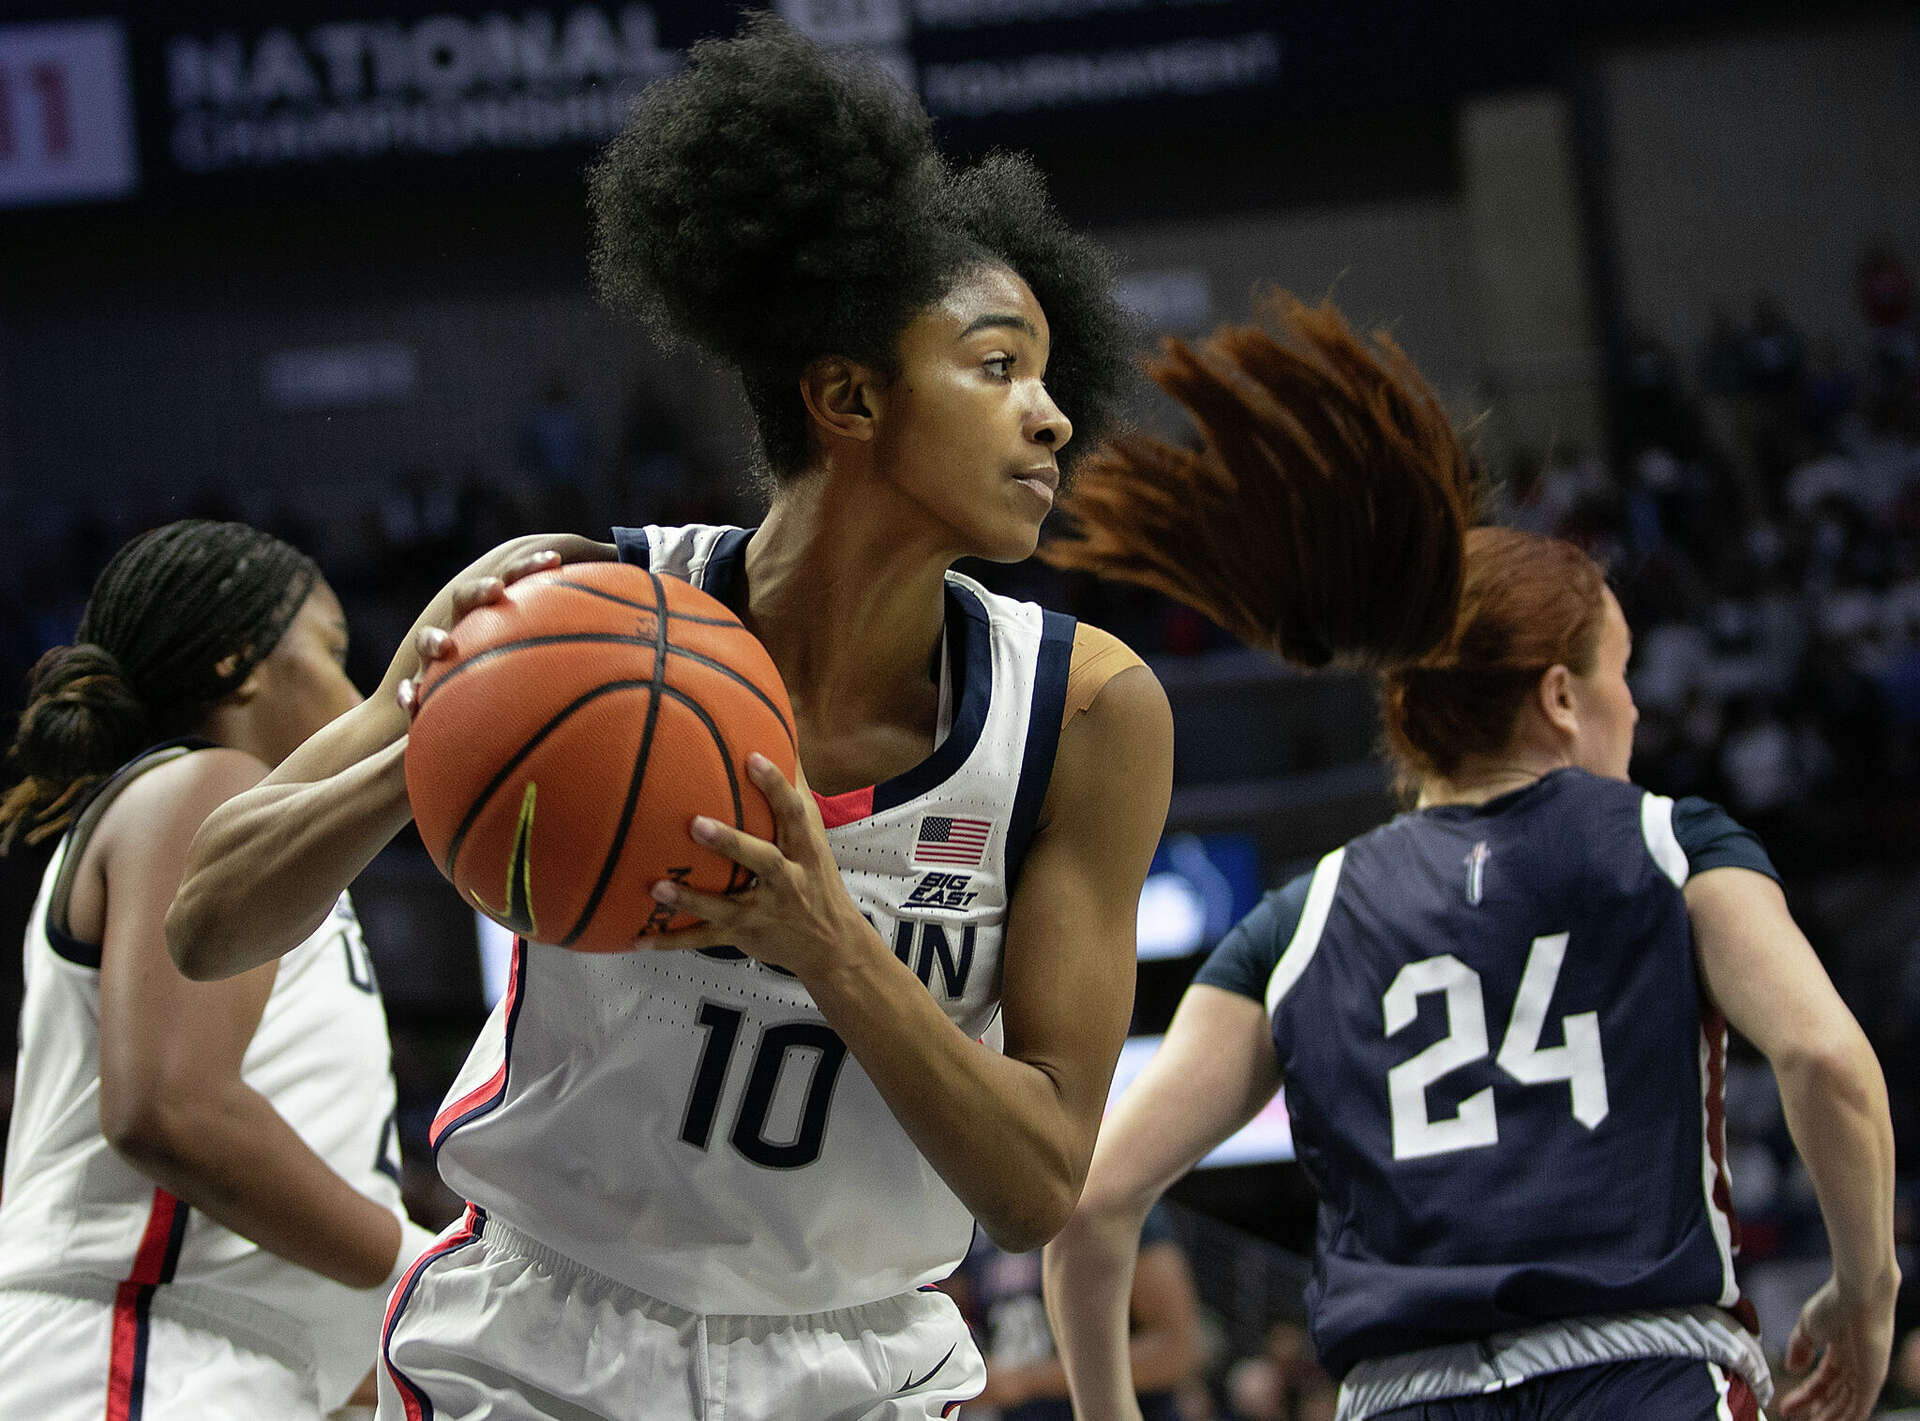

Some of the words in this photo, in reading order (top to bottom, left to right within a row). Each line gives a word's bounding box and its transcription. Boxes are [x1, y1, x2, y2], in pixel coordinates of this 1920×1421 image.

[165, 6, 672, 104] NATIONAL
[908, 887, 979, 906] EAST
[919, 872, 972, 890] BIG
[678, 1000, 850, 1171] 10
[1382, 931, 1609, 1161] 24
